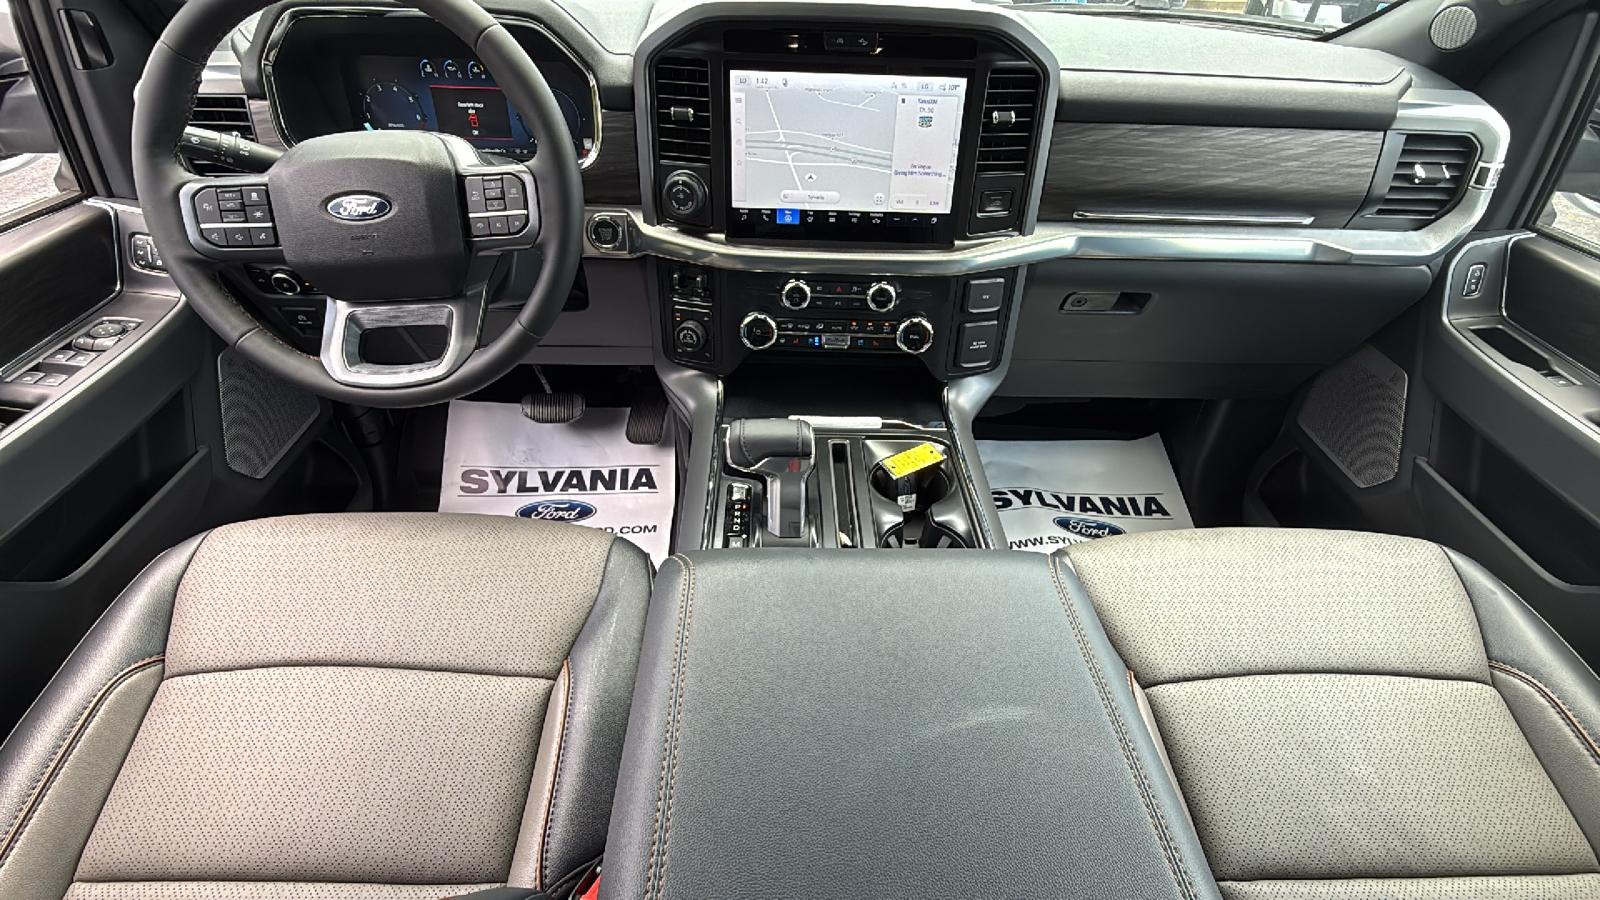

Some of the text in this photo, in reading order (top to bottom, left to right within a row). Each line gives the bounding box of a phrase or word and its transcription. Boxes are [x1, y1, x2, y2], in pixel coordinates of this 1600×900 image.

[365, 94, 371, 102] 2
[339, 198, 378, 216] Ford
[459, 468, 658, 494] SYLVANIA
[531, 502, 579, 521] Ford
[990, 489, 1172, 517] SYLVANIA
[1068, 518, 1113, 538] Ford
